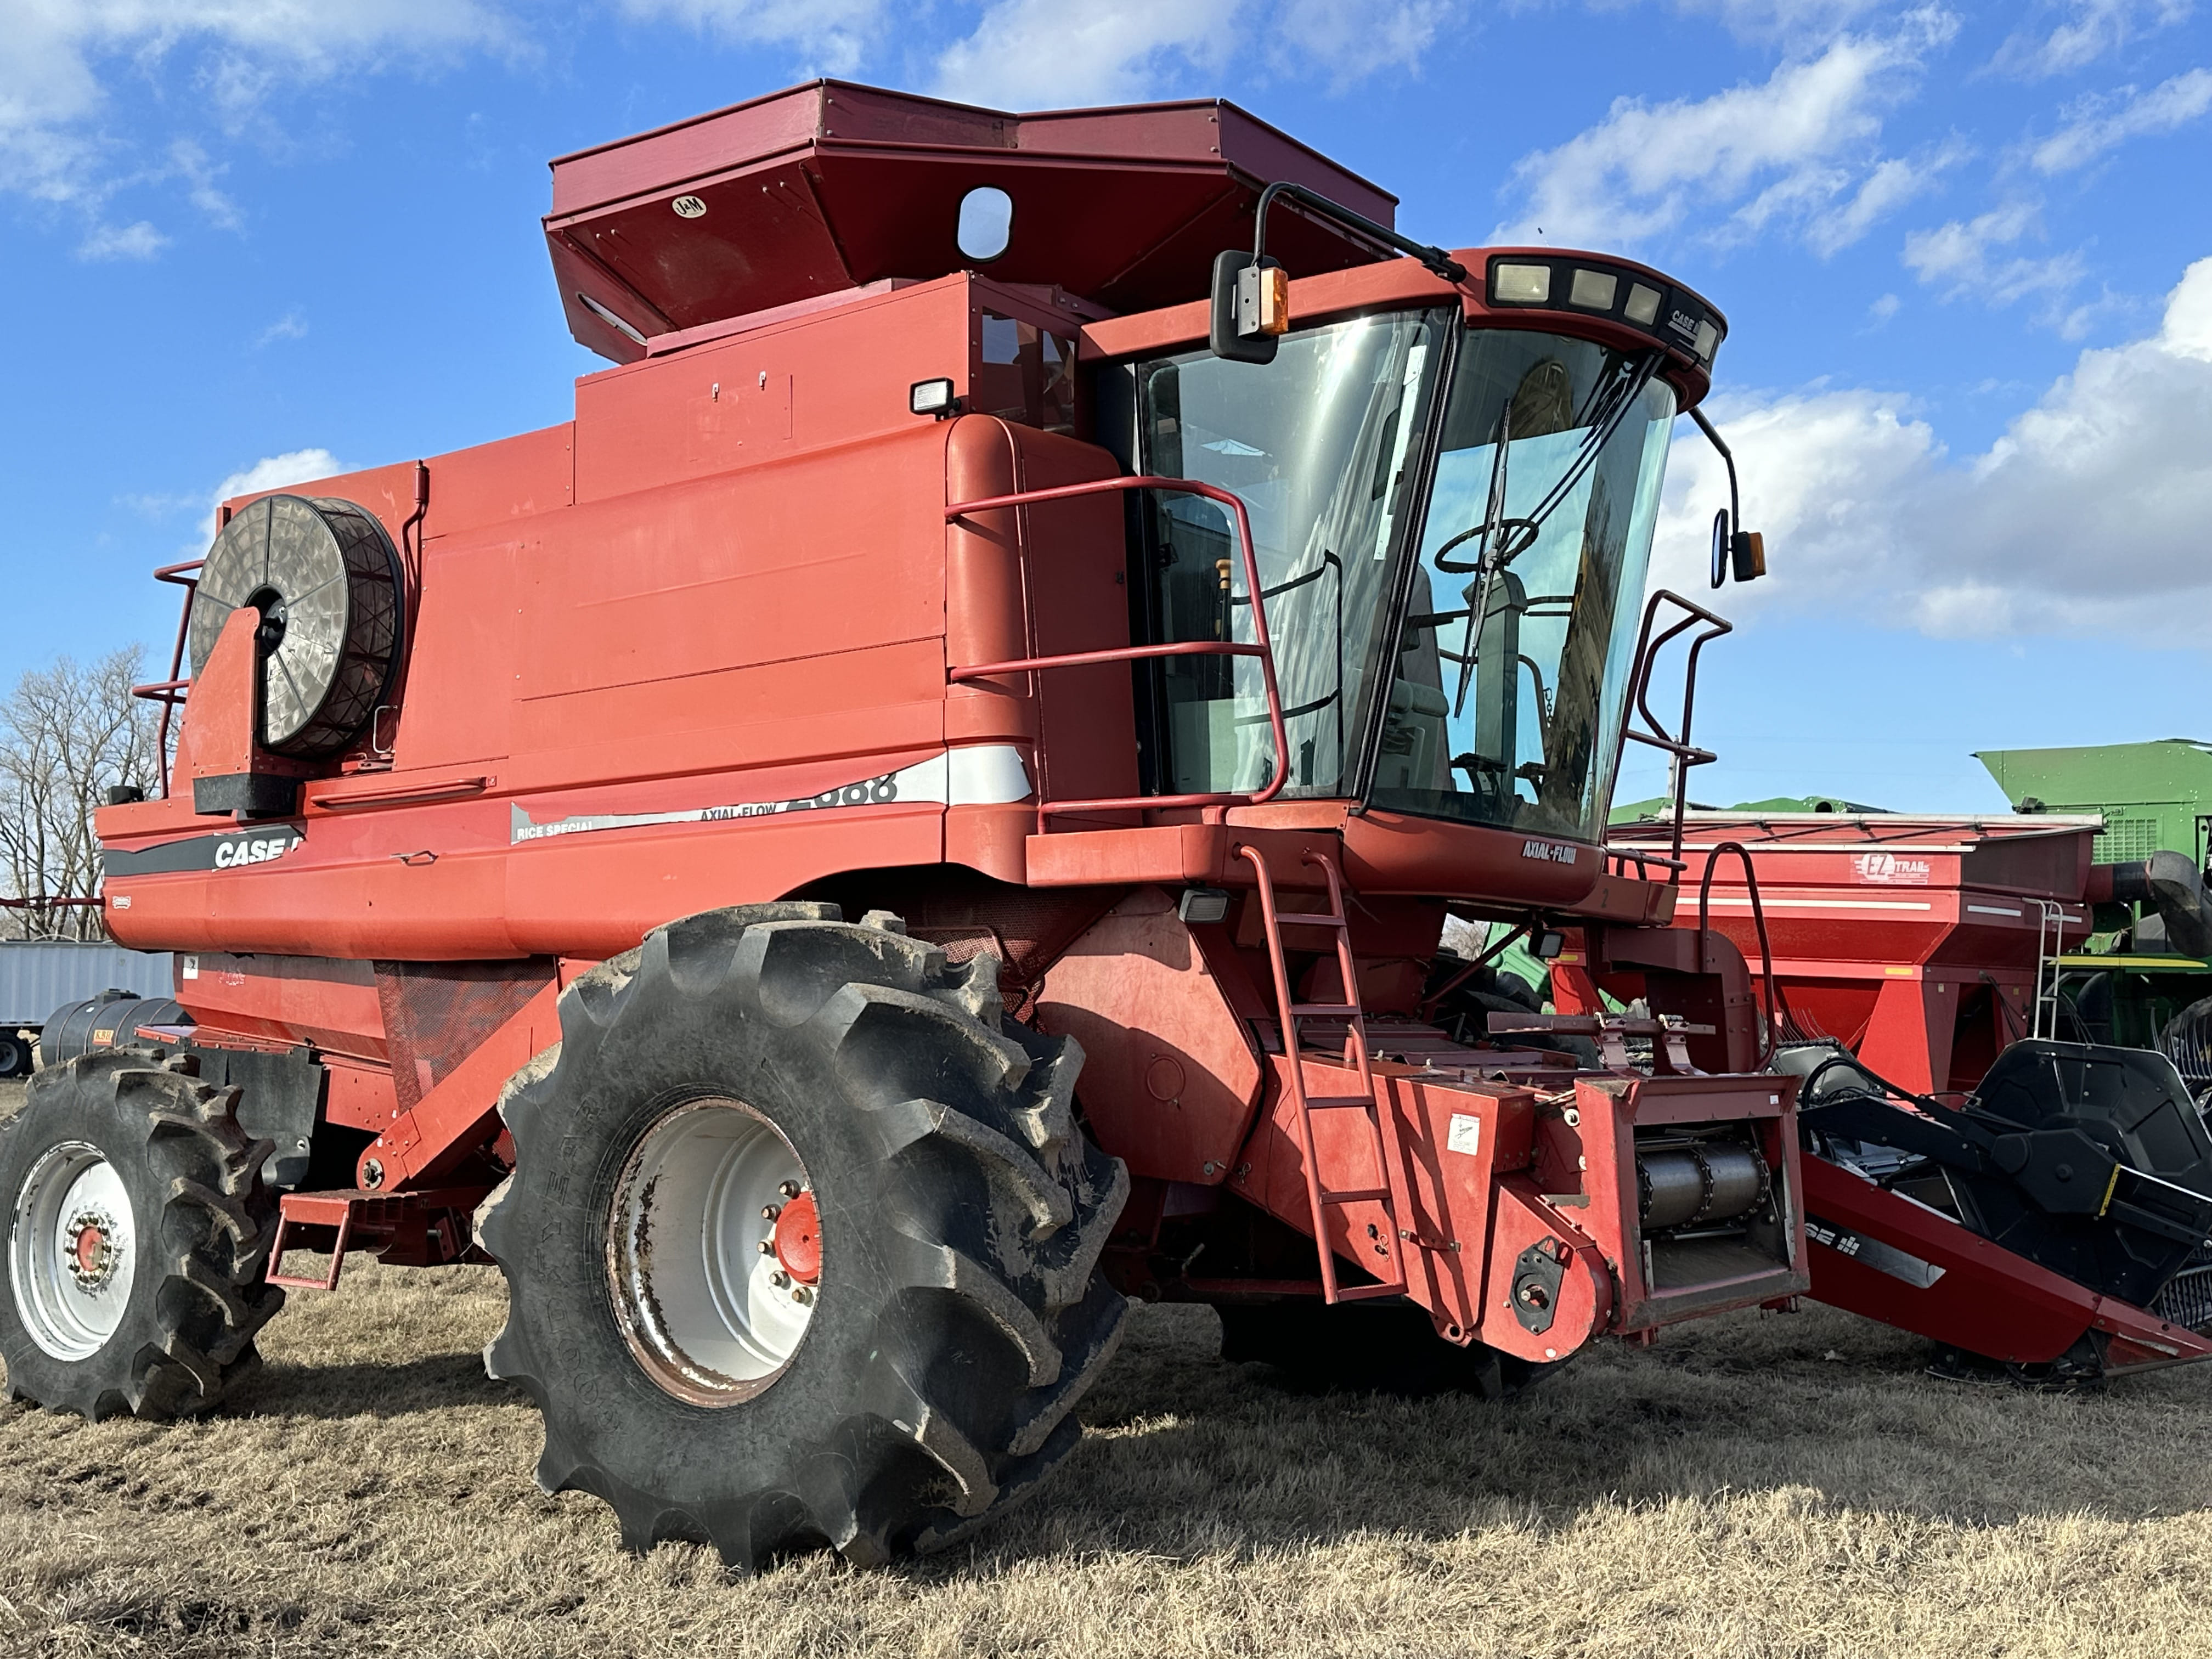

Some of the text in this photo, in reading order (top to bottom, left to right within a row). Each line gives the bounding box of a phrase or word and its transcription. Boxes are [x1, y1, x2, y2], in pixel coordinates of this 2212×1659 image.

[675, 198, 704, 215] J&M
[1672, 310, 1695, 330] CASE
[517, 826, 544, 840] RICE
[215, 838, 286, 868] CASE
[1867, 855, 1929, 876] EZ TRAIL
[1804, 1222, 1836, 1245] SE
